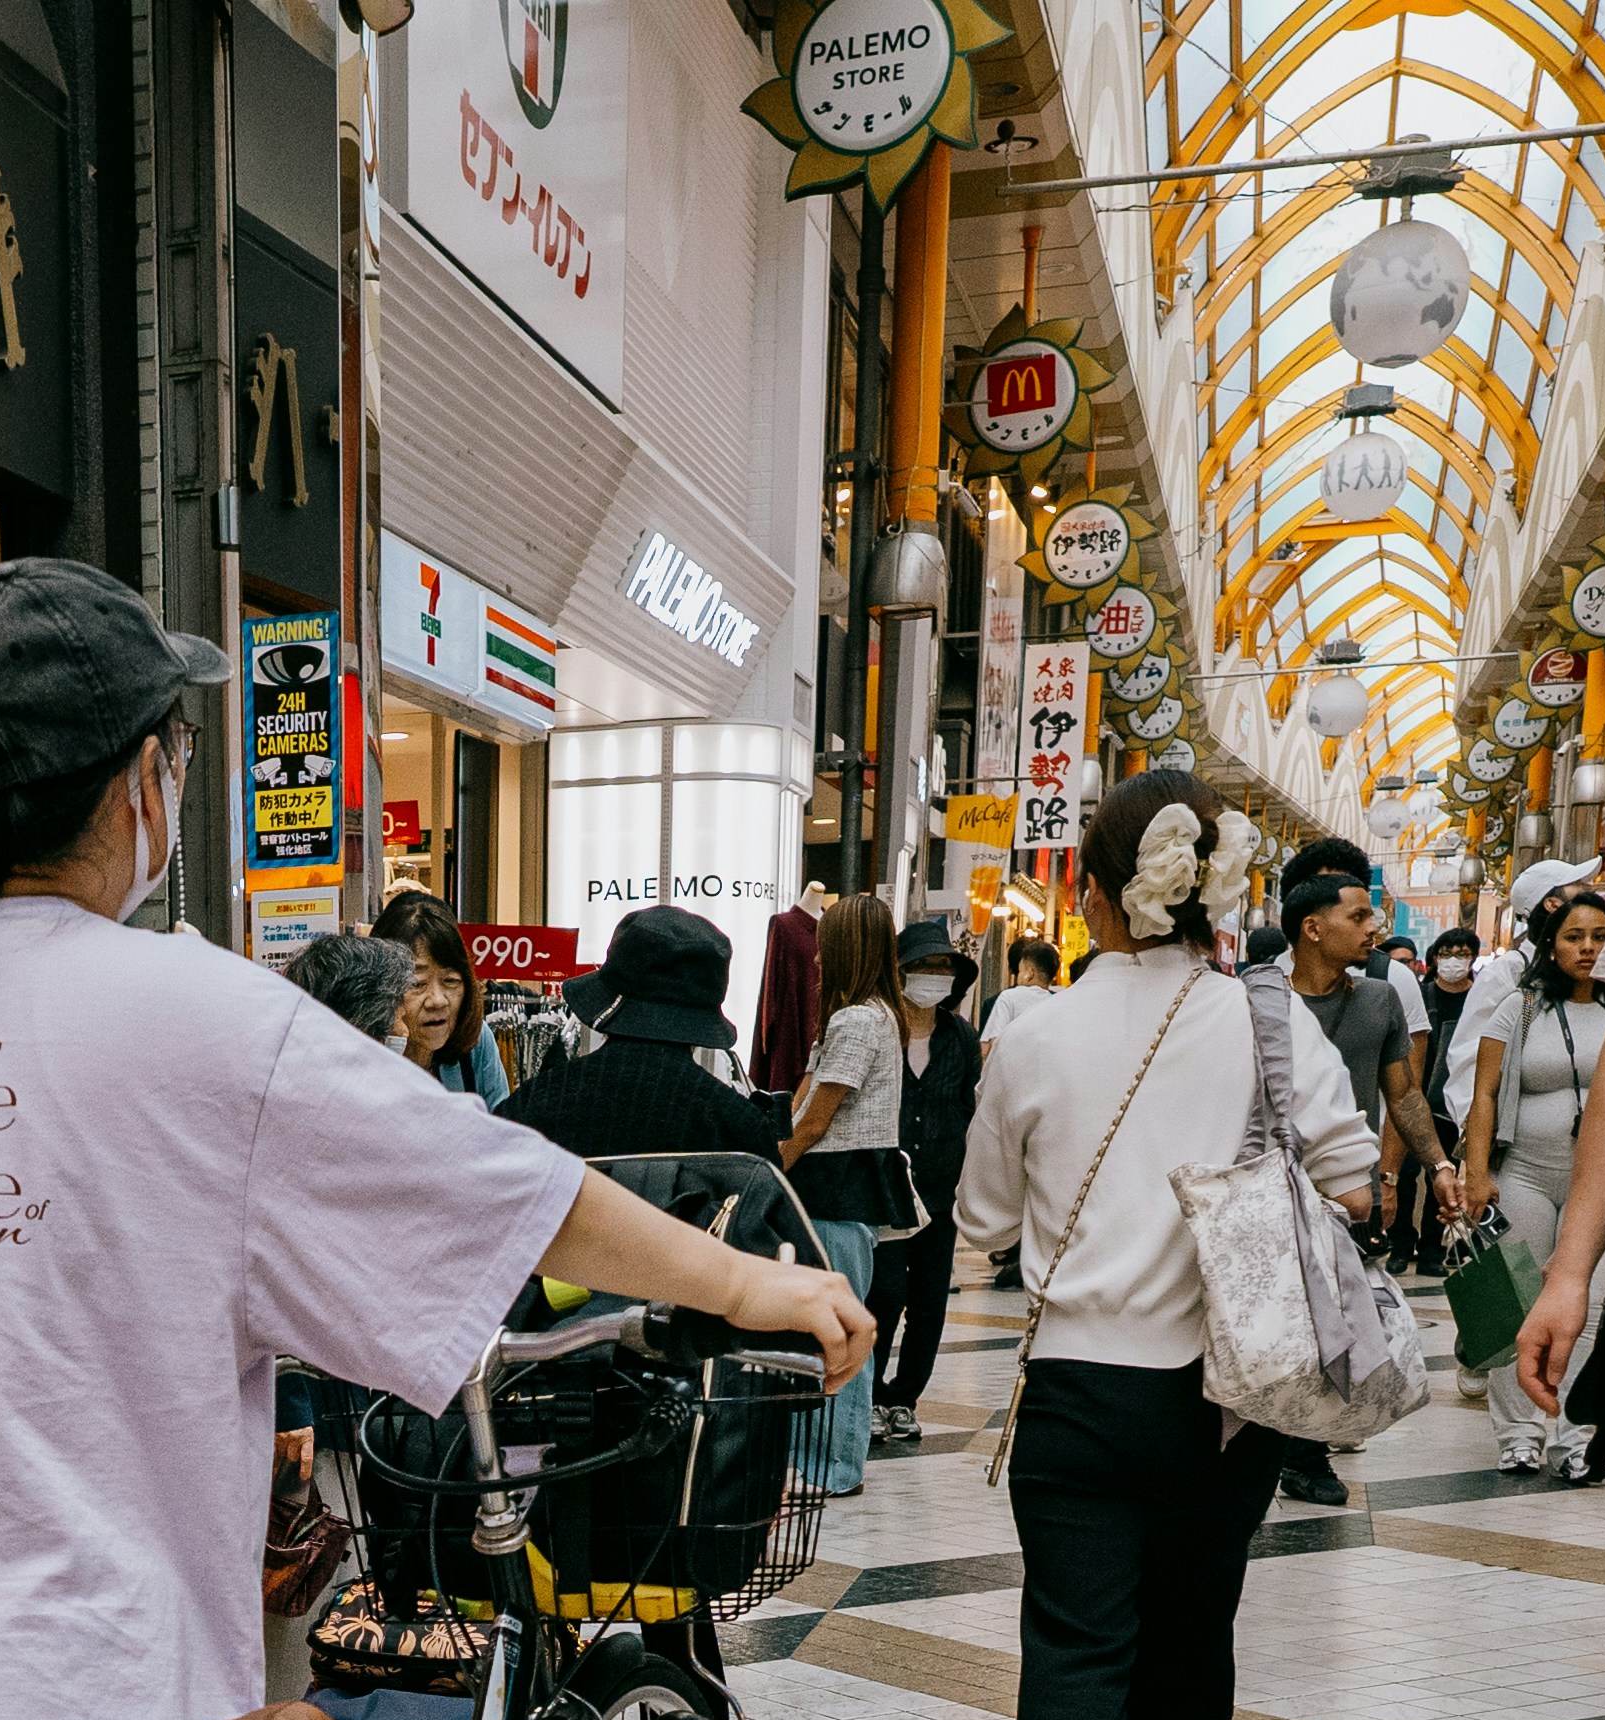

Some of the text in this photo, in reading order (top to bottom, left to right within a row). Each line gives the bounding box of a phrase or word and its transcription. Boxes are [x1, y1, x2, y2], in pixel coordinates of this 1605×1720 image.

[810, 24, 931, 66] PALEMO
[833, 62, 905, 90] STORE
[626, 532, 761, 668] PALEMO STORE
[1098, 600, 1144, 635] 油 そば
[252, 617, 331, 645] WARNING!
[277, 692, 306, 713] 24H
[257, 711, 328, 735] SECURITY
[257, 731, 329, 756] CAMERAS
[1024, 706, 1078, 843] 伊勢路
[259, 791, 328, 811] 防犯カメラ
[269, 809, 319, 828] 作動中!
[959, 802, 1014, 830] McCafé
[260, 832, 329, 846] 警察官パトロール
[276, 844, 313, 857] 強化地区
[732, 880, 775, 900] STORE
[25, 1198, 51, 1221] of
